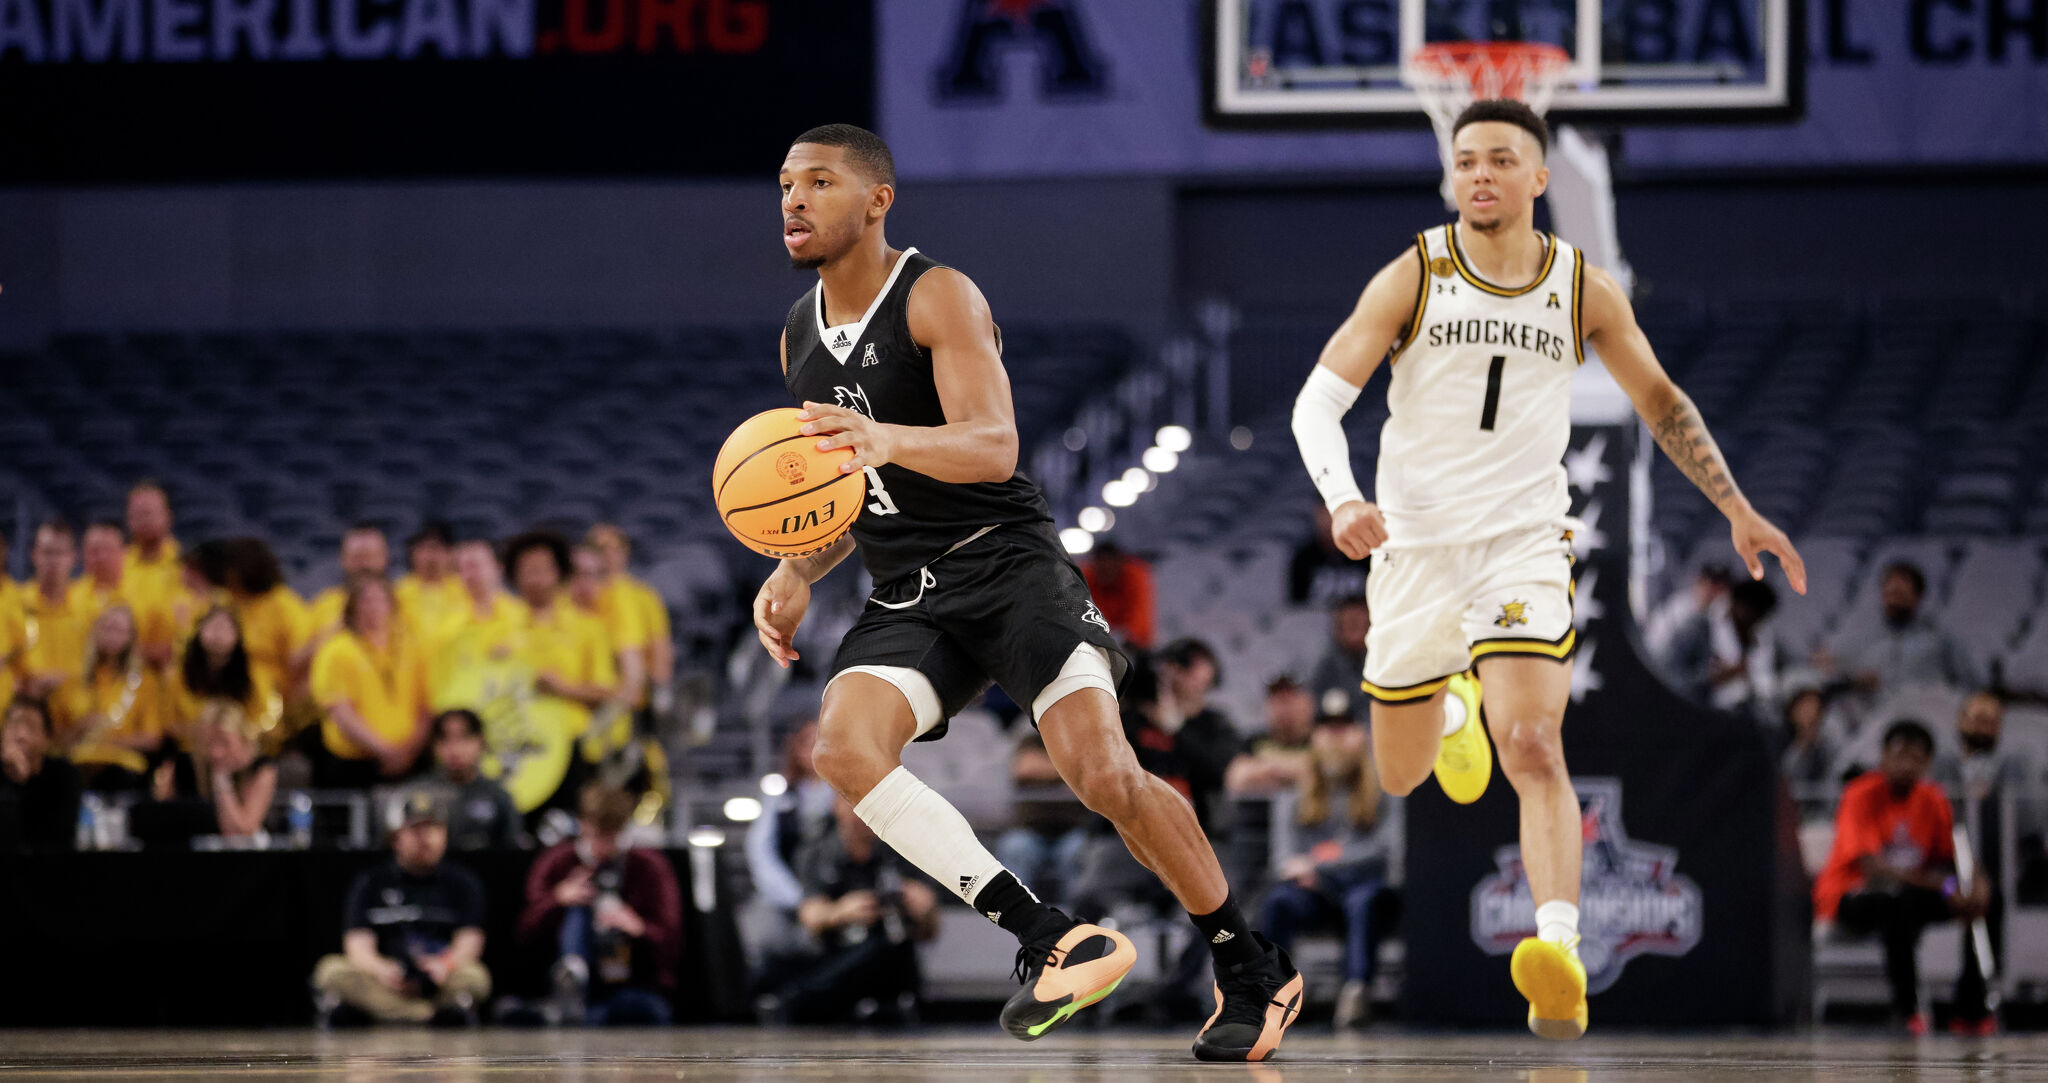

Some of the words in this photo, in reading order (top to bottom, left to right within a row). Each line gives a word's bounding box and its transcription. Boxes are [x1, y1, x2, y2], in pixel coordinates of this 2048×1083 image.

[832, 341, 852, 350] adidas
[1429, 319, 1564, 362] SHOCKERS
[1480, 355, 1506, 432] 1
[781, 500, 835, 534] EVO
